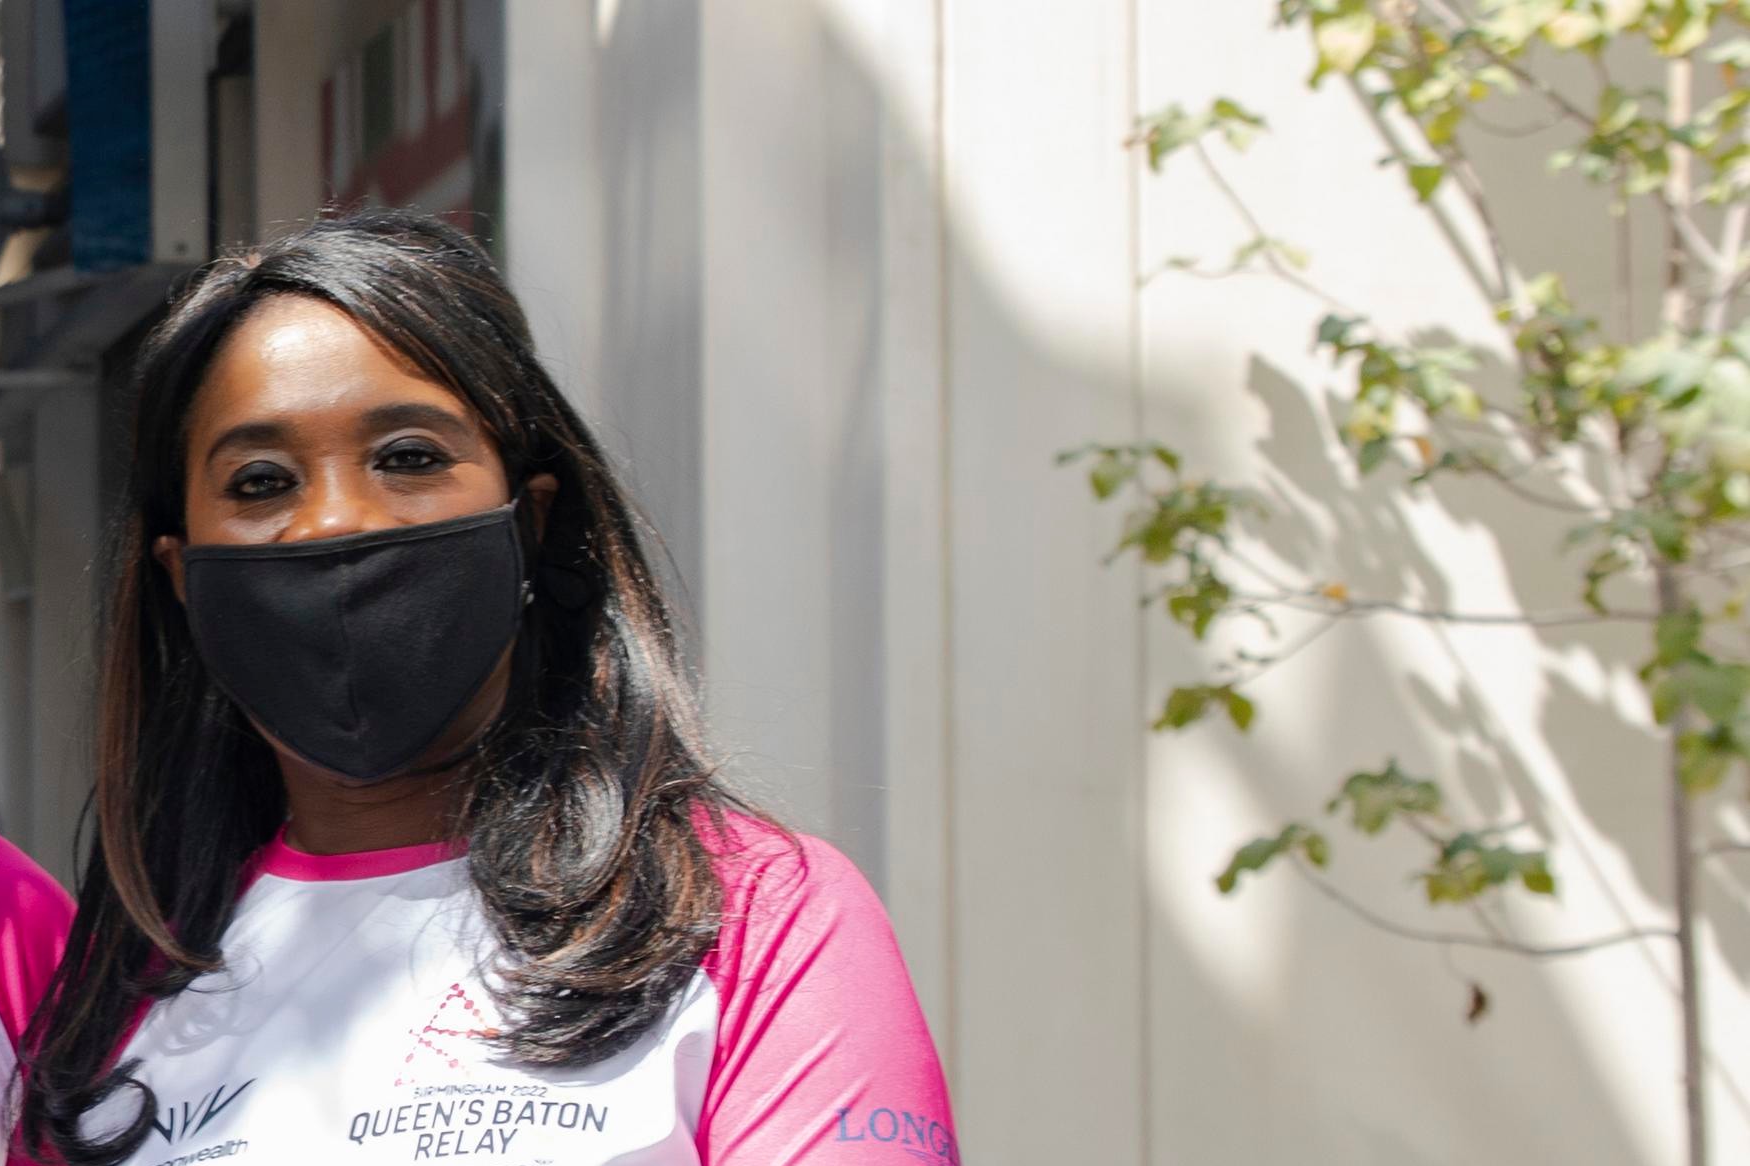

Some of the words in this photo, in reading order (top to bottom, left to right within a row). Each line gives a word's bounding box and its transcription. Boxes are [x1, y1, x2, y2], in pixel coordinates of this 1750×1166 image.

[349, 1100, 484, 1145] QUEEN'S
[493, 1100, 608, 1132] BATON
[414, 1128, 518, 1160] RELAY
